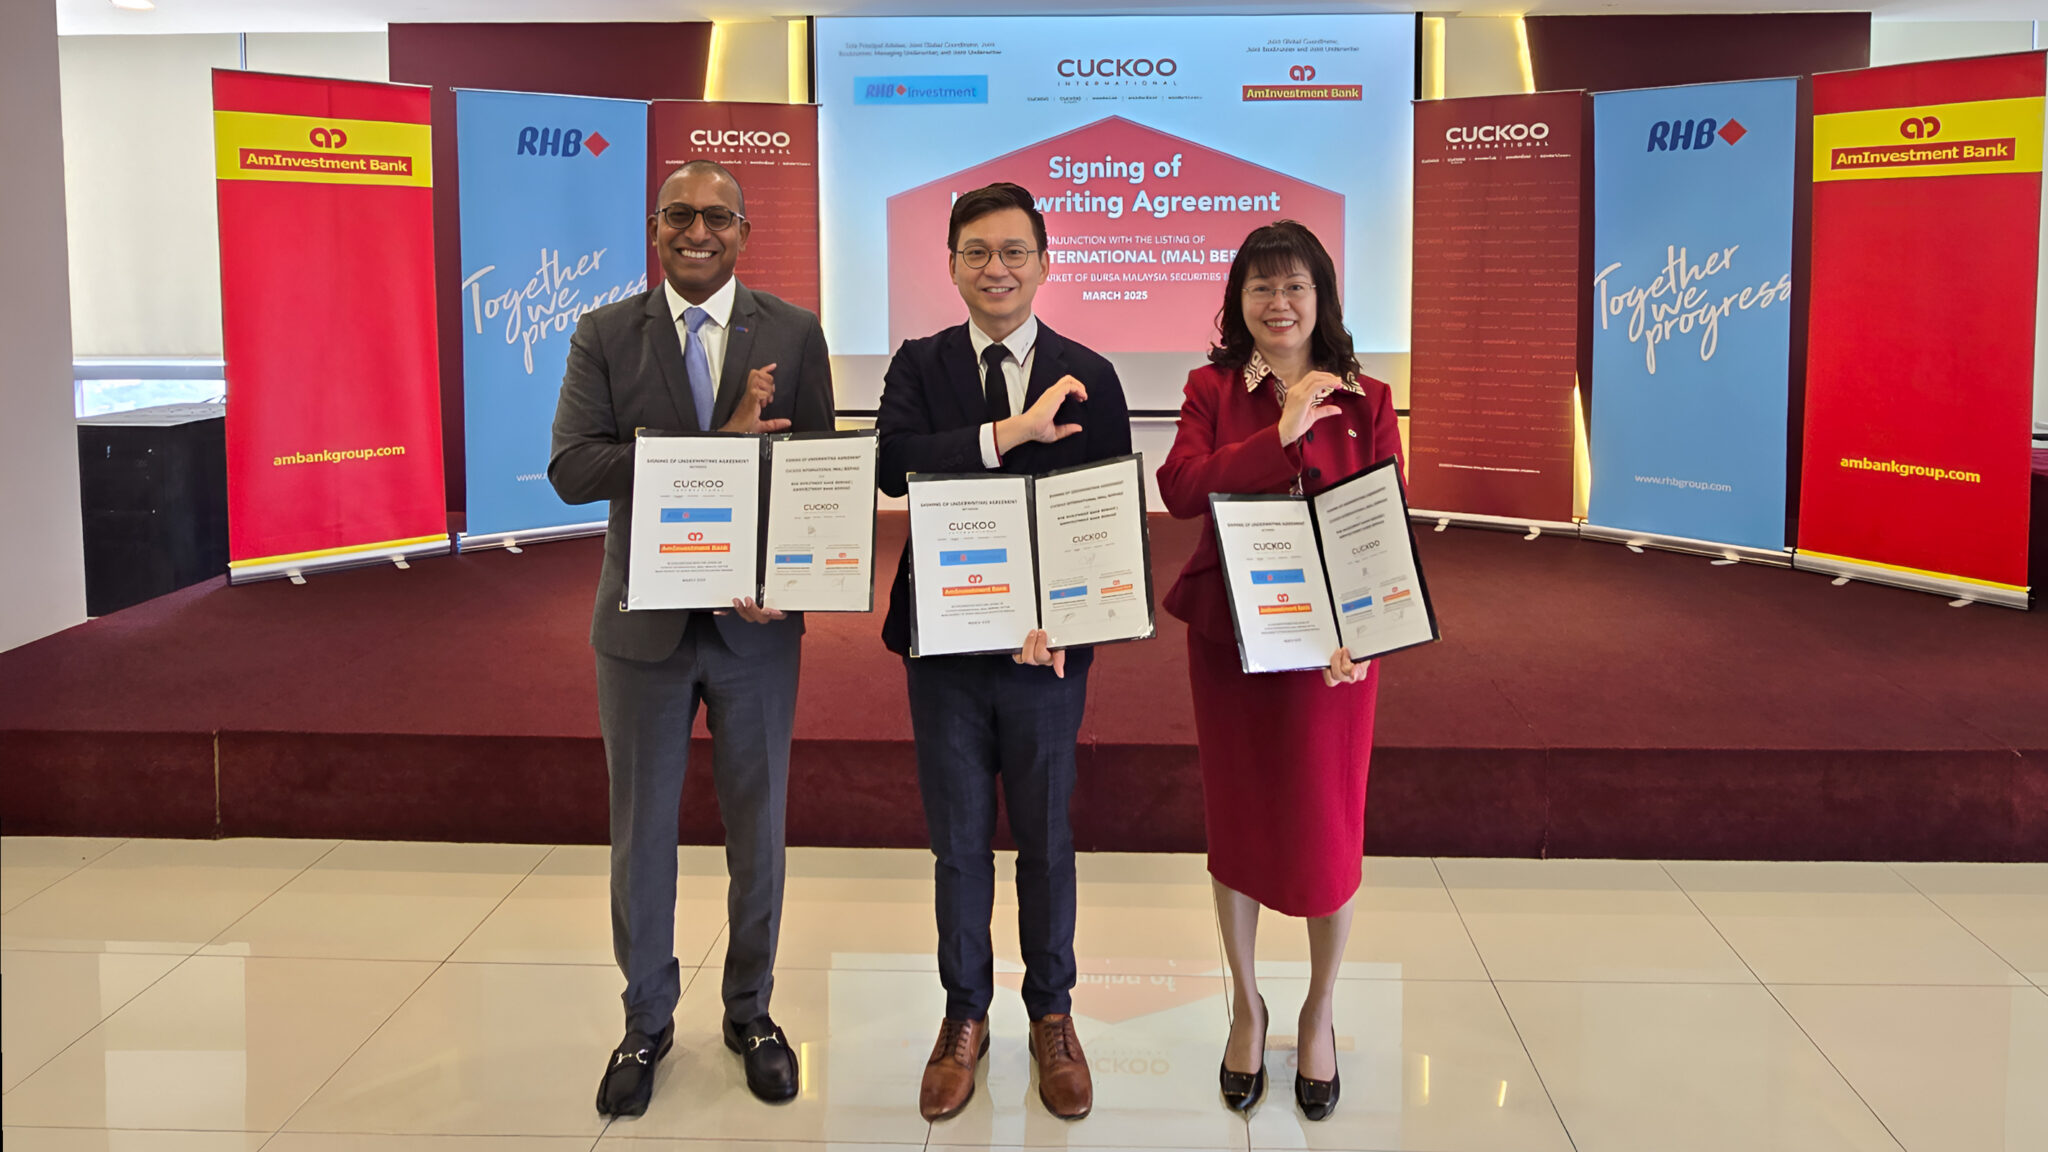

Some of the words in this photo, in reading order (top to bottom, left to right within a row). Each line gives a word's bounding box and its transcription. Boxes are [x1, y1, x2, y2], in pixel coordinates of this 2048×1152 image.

[1057, 58, 1177, 78] CUCKOO
[865, 83, 895, 99] RHB
[907, 86, 977, 98] Investment
[1246, 88, 1328, 98] AmInvestment
[1331, 88, 1359, 98] Bank
[517, 126, 583, 158] RHB
[690, 130, 791, 148] CUCKOO
[1446, 122, 1550, 143] CUCKOO
[1647, 118, 1717, 152] RHB
[691, 147, 791, 155] INTERNATIONAL
[1446, 141, 1549, 151] INTERNATIONAL
[1836, 147, 1959, 165] AmInvestment
[1963, 143, 2008, 158] Bank
[246, 153, 367, 171] AmInvestment
[370, 159, 408, 172] Bank
[1048, 155, 1145, 185] Signing
[1153, 154, 1182, 178] of
[1132, 190, 1281, 219] Agreement
[1109, 235, 1133, 245] WITH
[1135, 235, 1153, 245] THE
[1155, 235, 1190, 245] LISTING
[1192, 235, 1205, 244] OF
[1048, 249, 1157, 264] TERNATIONAL
[1161, 249, 1205, 265] (MAL)
[1075, 273, 1088, 282] OF
[1091, 273, 1120, 282] BURSA
[1122, 272, 1168, 282] MALAYSIA
[1170, 272, 1221, 281] SECURITIES
[462, 248, 607, 344] Together
[1083, 290, 1121, 300] MARCH
[1123, 290, 1148, 300] 2025
[1594, 245, 1740, 343] Together
[527, 287, 580, 323] we
[1651, 287, 1708, 322] we
[1645, 273, 1791, 375] progress
[273, 446, 406, 466] ambankgroup.com
[1840, 456, 1981, 483] ambankgroup.com
[673, 480, 724, 488] CUCKOO
[1634, 474, 1732, 493] www.rhbgroup.com
[803, 503, 839, 511] CUCKOO
[948, 521, 997, 531] CUCKOO
[1072, 531, 1108, 544] CUCKOO
[1253, 542, 1292, 551] CUCKOO
